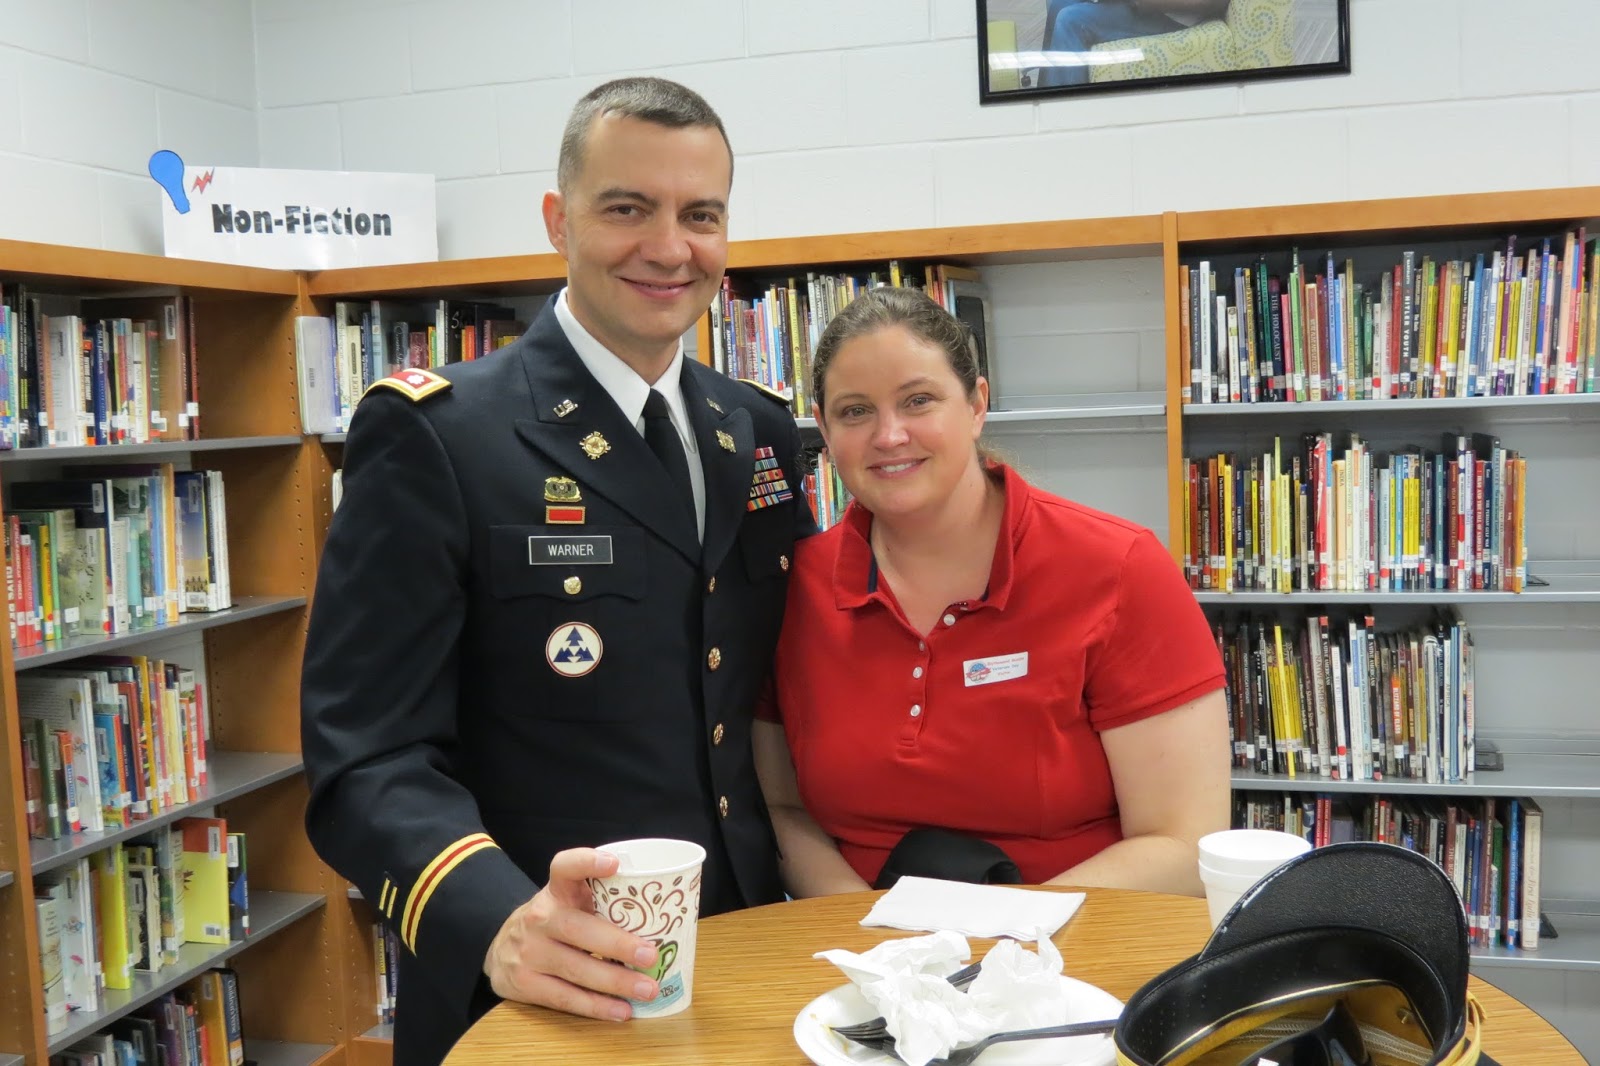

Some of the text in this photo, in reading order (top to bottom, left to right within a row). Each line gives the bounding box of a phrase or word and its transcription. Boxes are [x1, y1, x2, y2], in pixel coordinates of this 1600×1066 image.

[211, 203, 392, 236] Non-Fiction
[1271, 294, 1281, 361] THE HOLOCAUST
[548, 543, 594, 557] WARNER
[1315, 655, 1325, 715] NATIVE AMERICA
